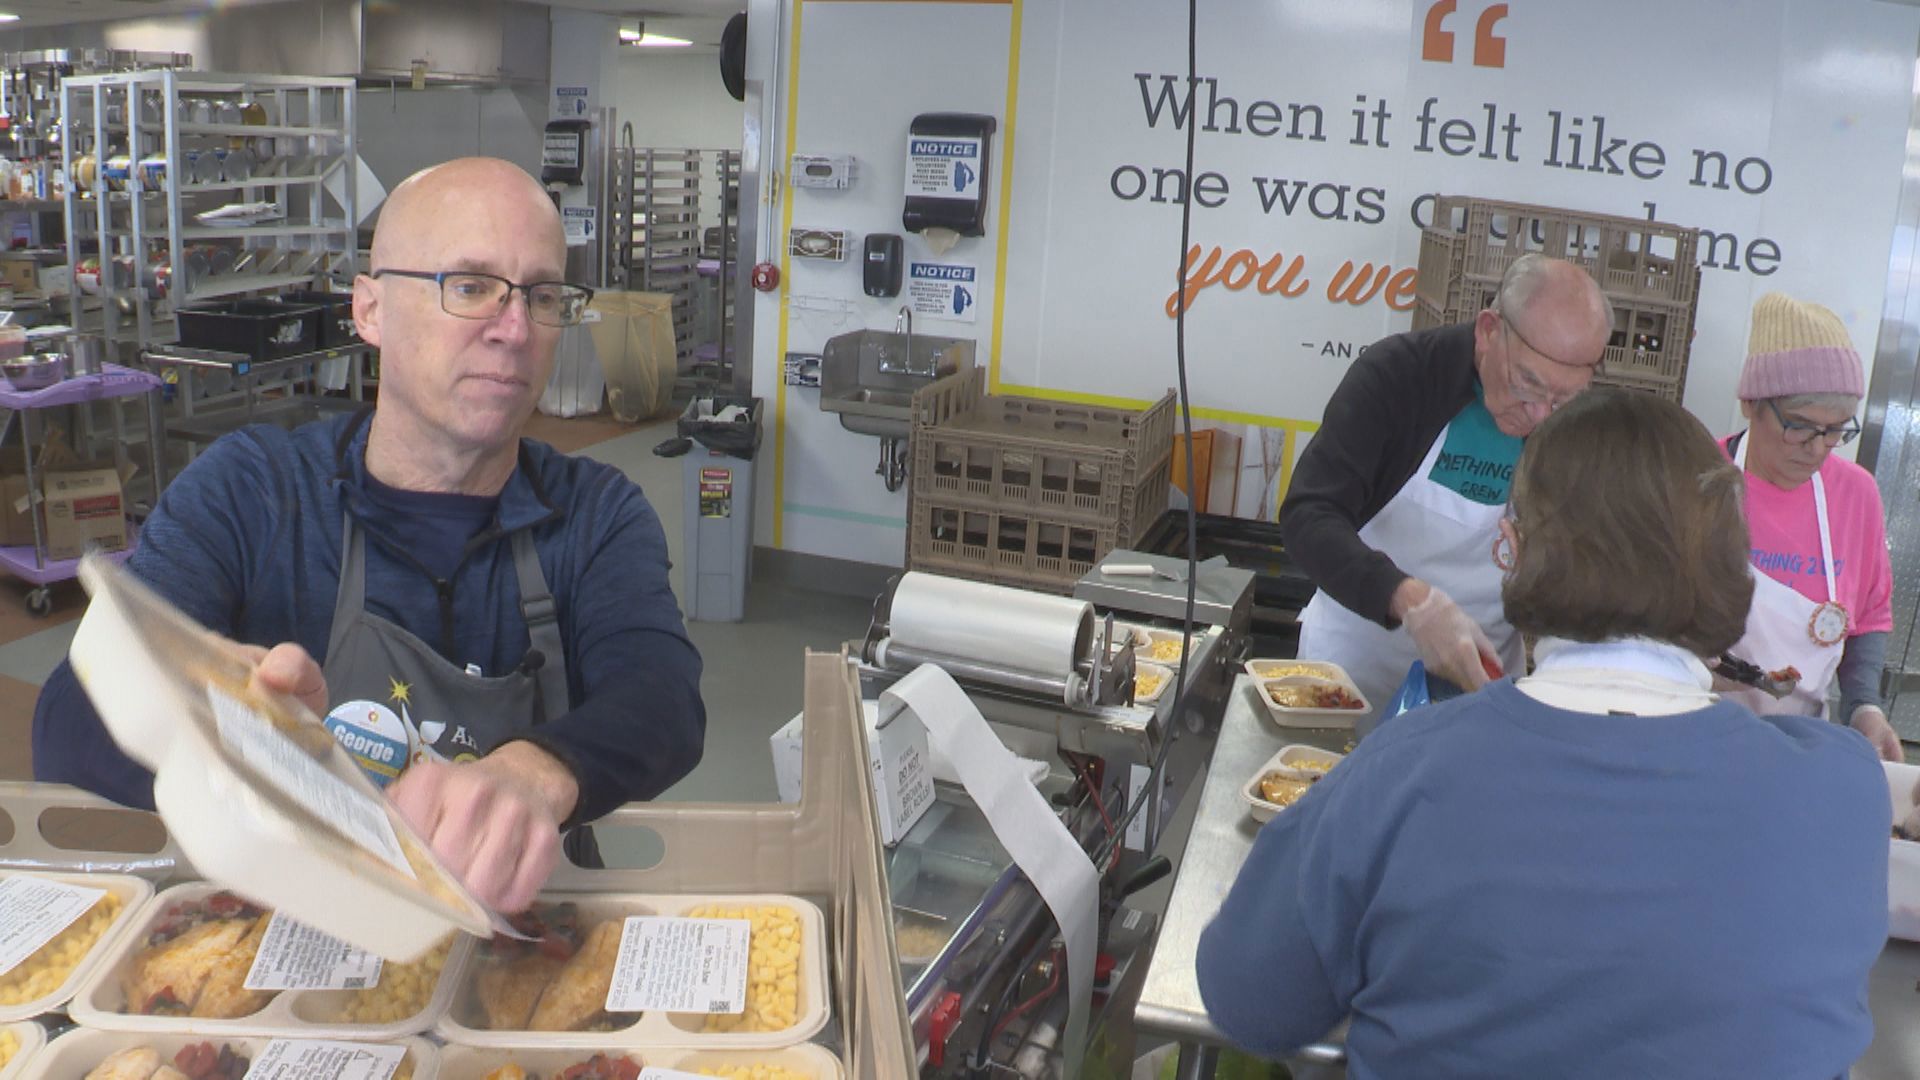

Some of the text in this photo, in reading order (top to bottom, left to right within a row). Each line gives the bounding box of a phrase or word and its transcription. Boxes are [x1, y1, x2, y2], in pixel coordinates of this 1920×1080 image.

[1135, 72, 1774, 197] When it felt like no
[915, 142, 974, 155] NOTICE
[1109, 162, 1231, 209] one
[1253, 176, 1387, 226] was
[1700, 228, 1781, 276] me
[915, 266, 972, 280] NOTICE
[1165, 242, 1311, 320] you
[1321, 340, 1352, 358] AN
[1807, 556, 1818, 575] 2
[333, 724, 395, 762] George
[897, 806, 913, 828] LABEL
